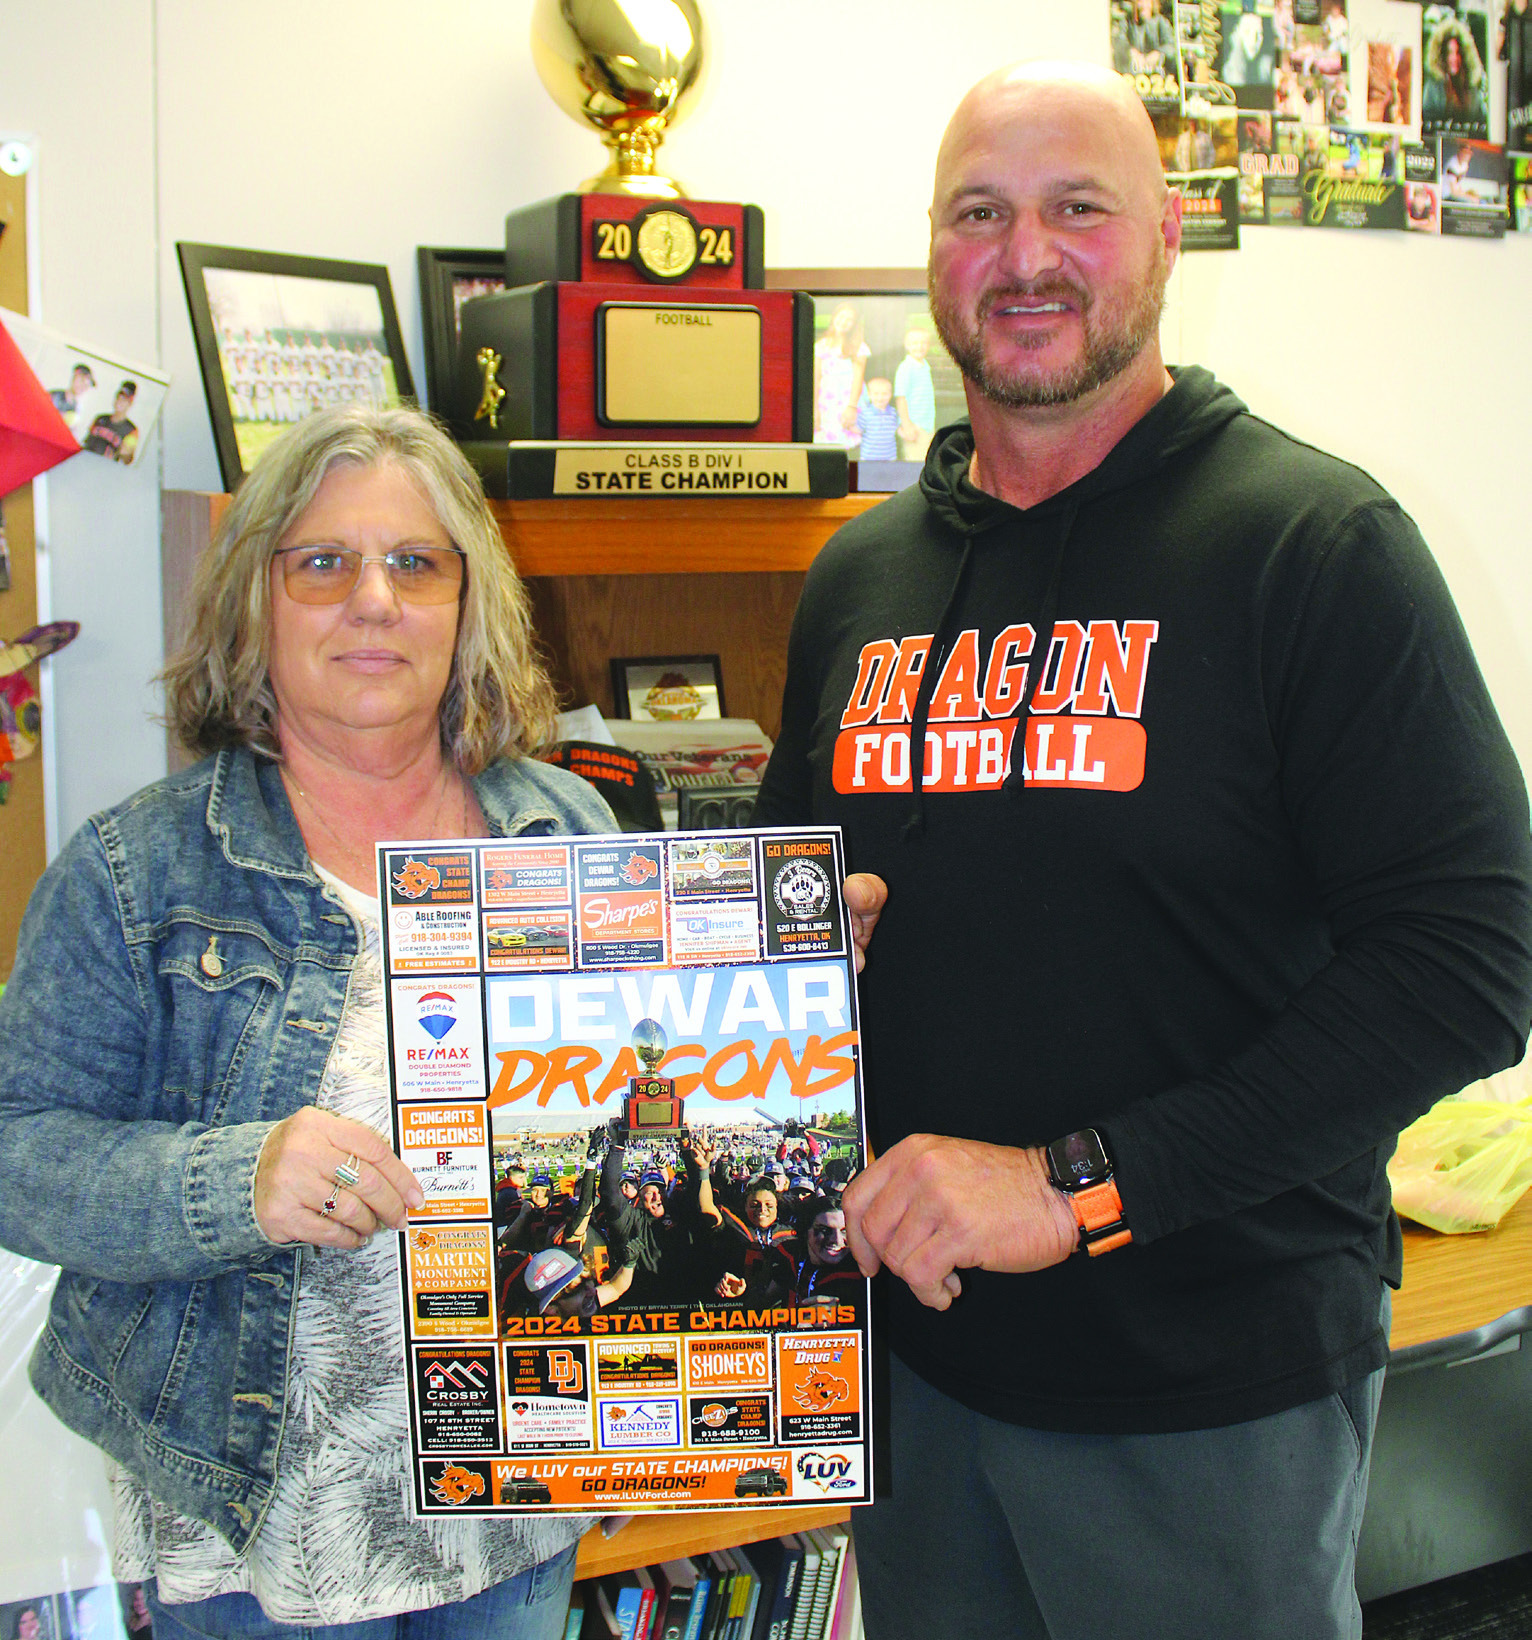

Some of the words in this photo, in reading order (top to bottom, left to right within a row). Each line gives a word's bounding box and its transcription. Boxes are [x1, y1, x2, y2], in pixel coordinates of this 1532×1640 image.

[1241, 153, 1299, 176] GRAD
[598, 223, 631, 260] 20
[700, 228, 733, 265] 24
[655, 313, 712, 326] FOOTBALL
[625, 454, 683, 468] CLASS
[689, 455, 700, 468] B
[706, 455, 732, 468] DIV
[738, 455, 742, 468] I
[576, 472, 653, 490] STATE
[661, 472, 788, 490] CHAMPION
[840, 620, 1159, 730] DRAGON
[571, 749, 638, 773] DRAGONS
[570, 764, 634, 786] CHAMPS
[766, 845, 781, 857] GO
[784, 843, 831, 856] DRAGONS!
[428, 857, 469, 865] CONGRATS
[583, 853, 619, 863] CONGRATS
[446, 868, 469, 876] STATE
[516, 870, 562, 878] CONGRATS
[589, 866, 614, 875] DEWAR
[442, 879, 470, 888] CHAMP
[517, 878, 561, 886] DRAGONS!
[584, 877, 619, 887] DRAGONS!
[431, 890, 470, 899] DRAGONS!
[584, 898, 658, 929] Sharpe's
[689, 920, 706, 930] OK
[709, 920, 744, 929] Insure
[777, 924, 789, 932] 520
[791, 924, 796, 932] E
[797, 922, 832, 931] BOLLINGER
[412, 932, 472, 942] 918-304-9394
[421, 1004, 454, 1013] RE/MAX
[488, 965, 847, 1044] DEWAR
[407, 1047, 469, 1061] RE/MAX
[486, 1030, 859, 1112] DRAGONS
[410, 1110, 475, 1125] CONGRATS
[405, 1127, 483, 1146] DRAGONS!
[437, 1151, 452, 1165] BF
[420, 1177, 475, 1192] Burnett's
[437, 1231, 486, 1239] CONGRATS
[439, 1241, 486, 1249] DRAGONS!
[415, 1252, 486, 1267] MARTIN
[415, 1268, 487, 1279] MONUMENT
[425, 1279, 478, 1288] COMPANY
[506, 1316, 581, 1336] 2024
[591, 1312, 680, 1334] STATE
[689, 1305, 856, 1331] CHAMPIONS
[600, 1344, 651, 1355] ADVANCED
[692, 1343, 706, 1351] GO
[709, 1341, 765, 1351] DRAGONS!
[783, 1337, 856, 1350] HENRYETTA
[794, 1351, 830, 1364] DRUG
[427, 1391, 489, 1400] CROSBY
[531, 1403, 586, 1411] Hometown
[610, 1422, 670, 1431] KENNEDY
[789, 1430, 853, 1438] henryettadrug.com
[496, 1465, 527, 1479] We
[531, 1464, 570, 1478] LUV
[572, 1465, 606, 1477] our
[611, 1460, 669, 1477] STATE
[673, 1456, 788, 1474] CHAMPIONS!
[804, 1461, 853, 1480] LUV
[581, 1478, 608, 1492] GO
[612, 1475, 707, 1491] DRAGONS!
[833, 1480, 852, 1488] Ford
